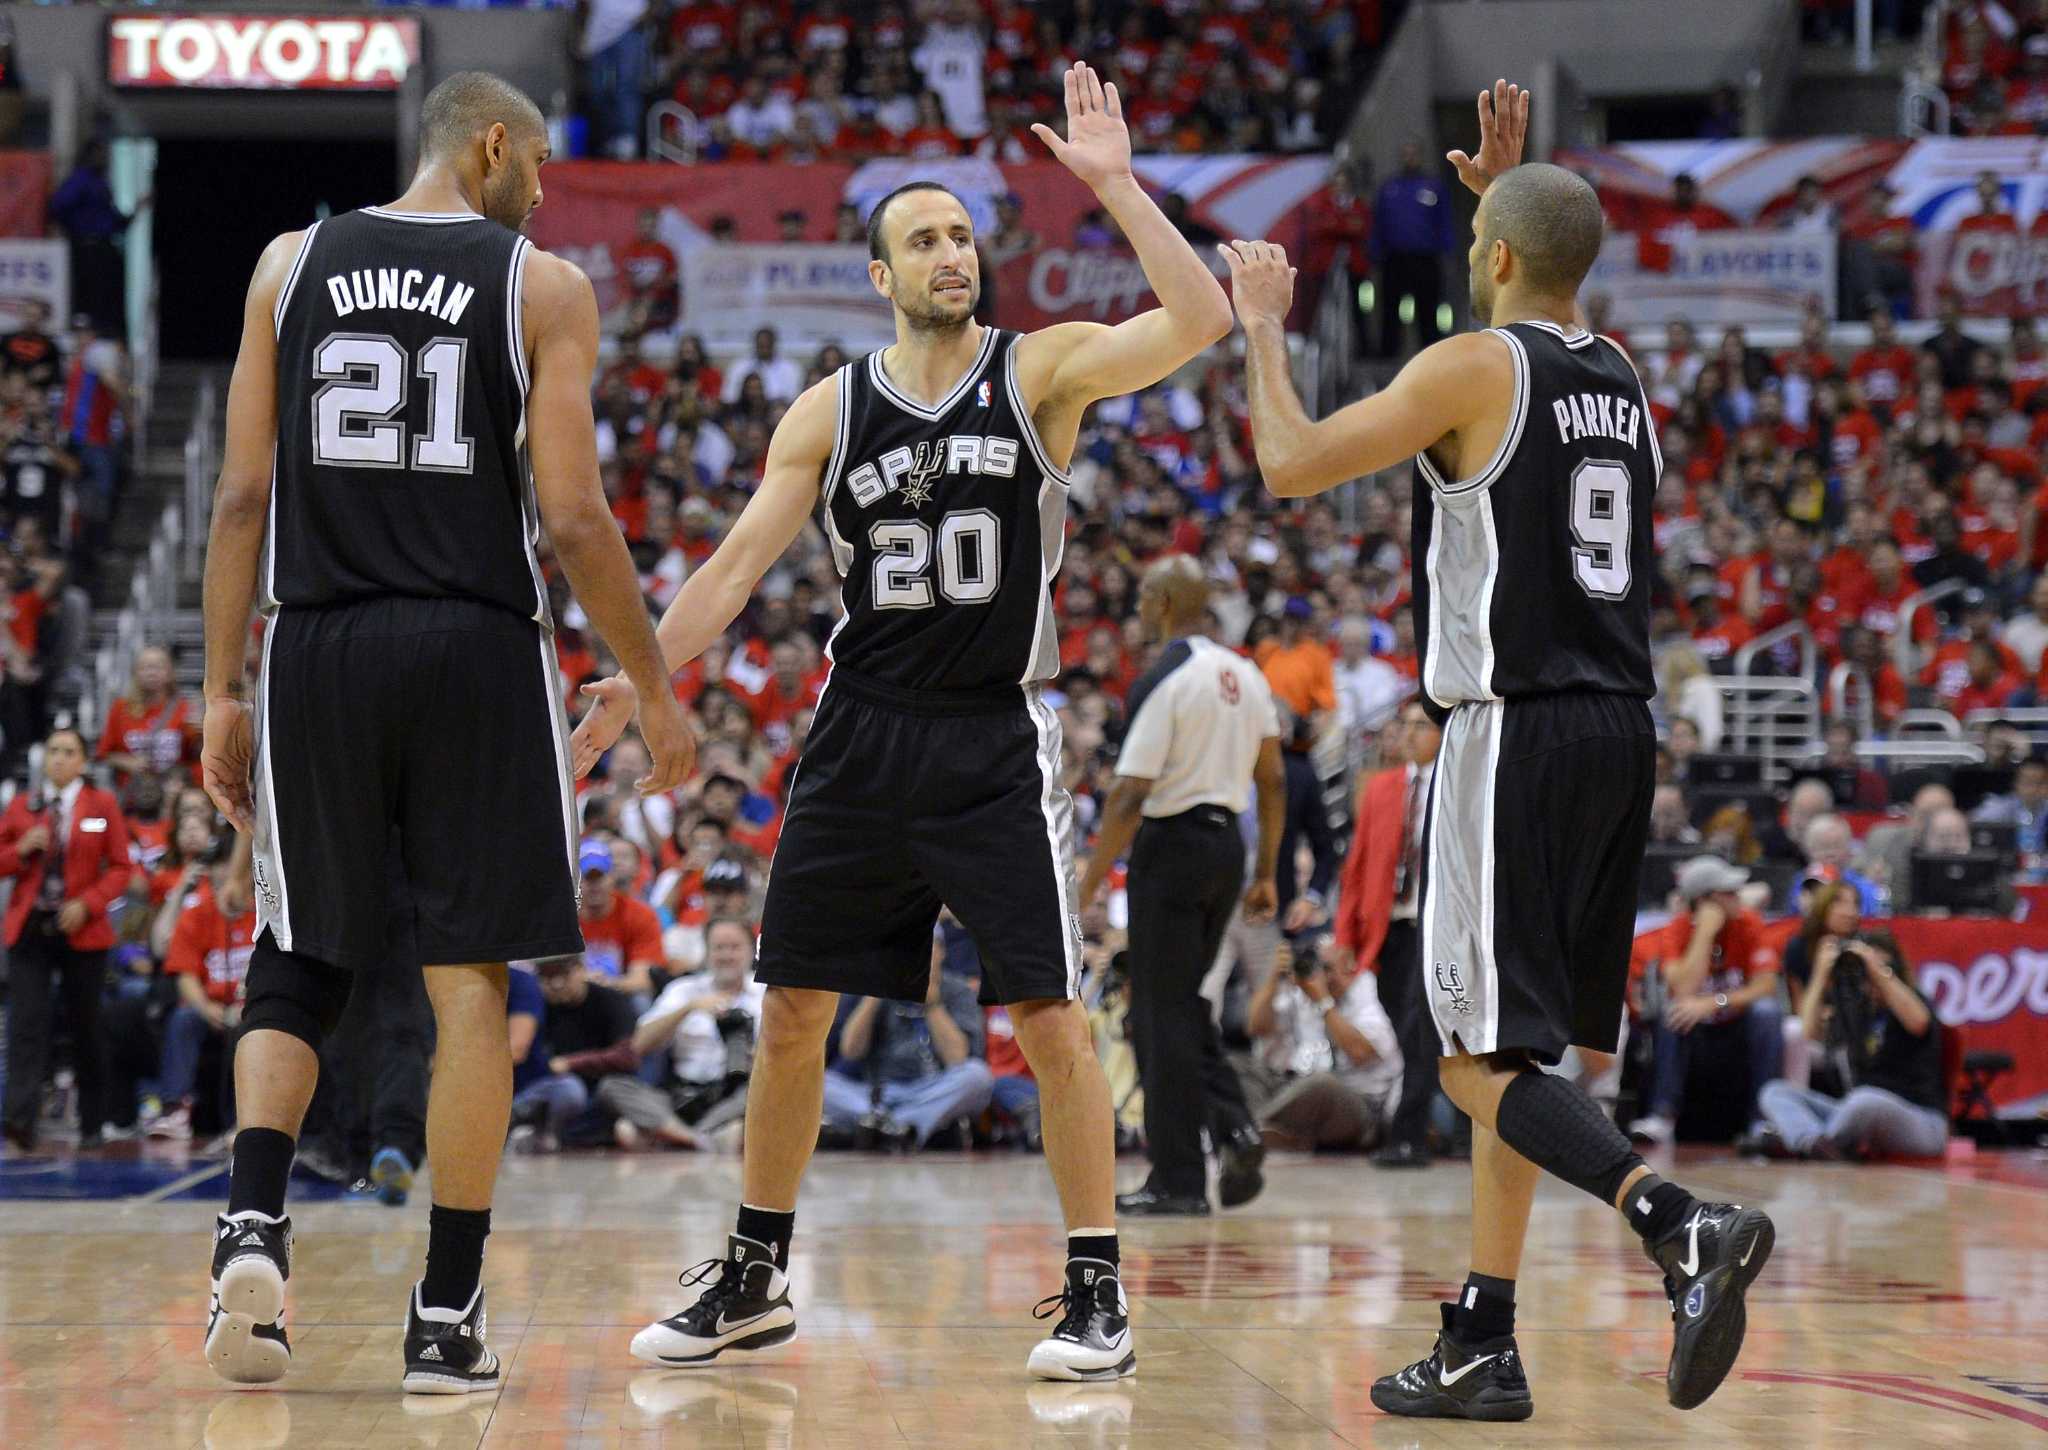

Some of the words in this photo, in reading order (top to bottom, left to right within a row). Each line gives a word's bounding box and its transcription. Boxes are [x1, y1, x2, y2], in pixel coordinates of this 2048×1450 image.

[111, 18, 407, 81] TOYOTA
[326, 268, 475, 325] DUNCAN
[311, 331, 475, 475] 21
[1552, 393, 1640, 450] PARKER
[846, 435, 1020, 510] SPURS
[868, 507, 1002, 611] 20
[1569, 456, 1632, 602] 9
